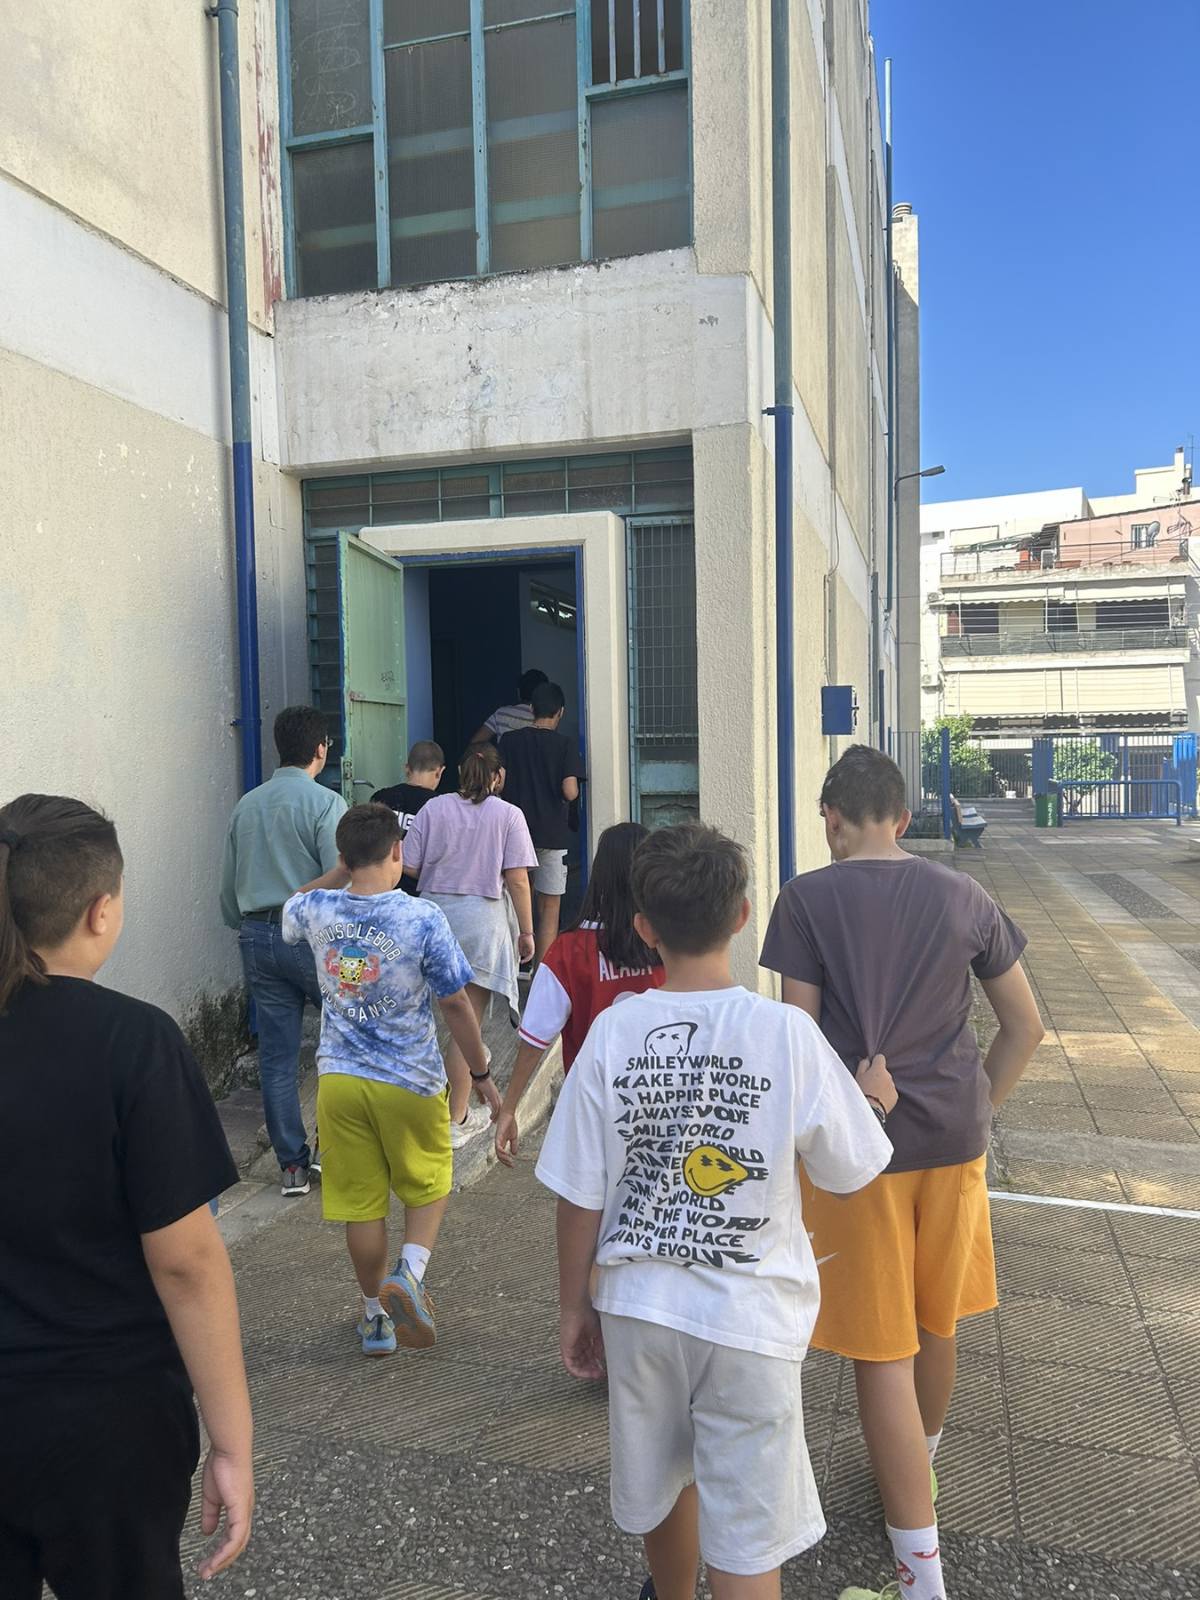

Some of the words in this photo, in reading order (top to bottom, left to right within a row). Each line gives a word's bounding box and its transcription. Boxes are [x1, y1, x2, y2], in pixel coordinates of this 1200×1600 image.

[316, 923, 401, 961] MUSCLEBOB
[710, 1071, 771, 1092] WORLD
[618, 1093, 634, 1106] A
[709, 1087, 761, 1109] PLACE
[652, 1206, 682, 1224] THE
[681, 1227, 746, 1248] PLACE
